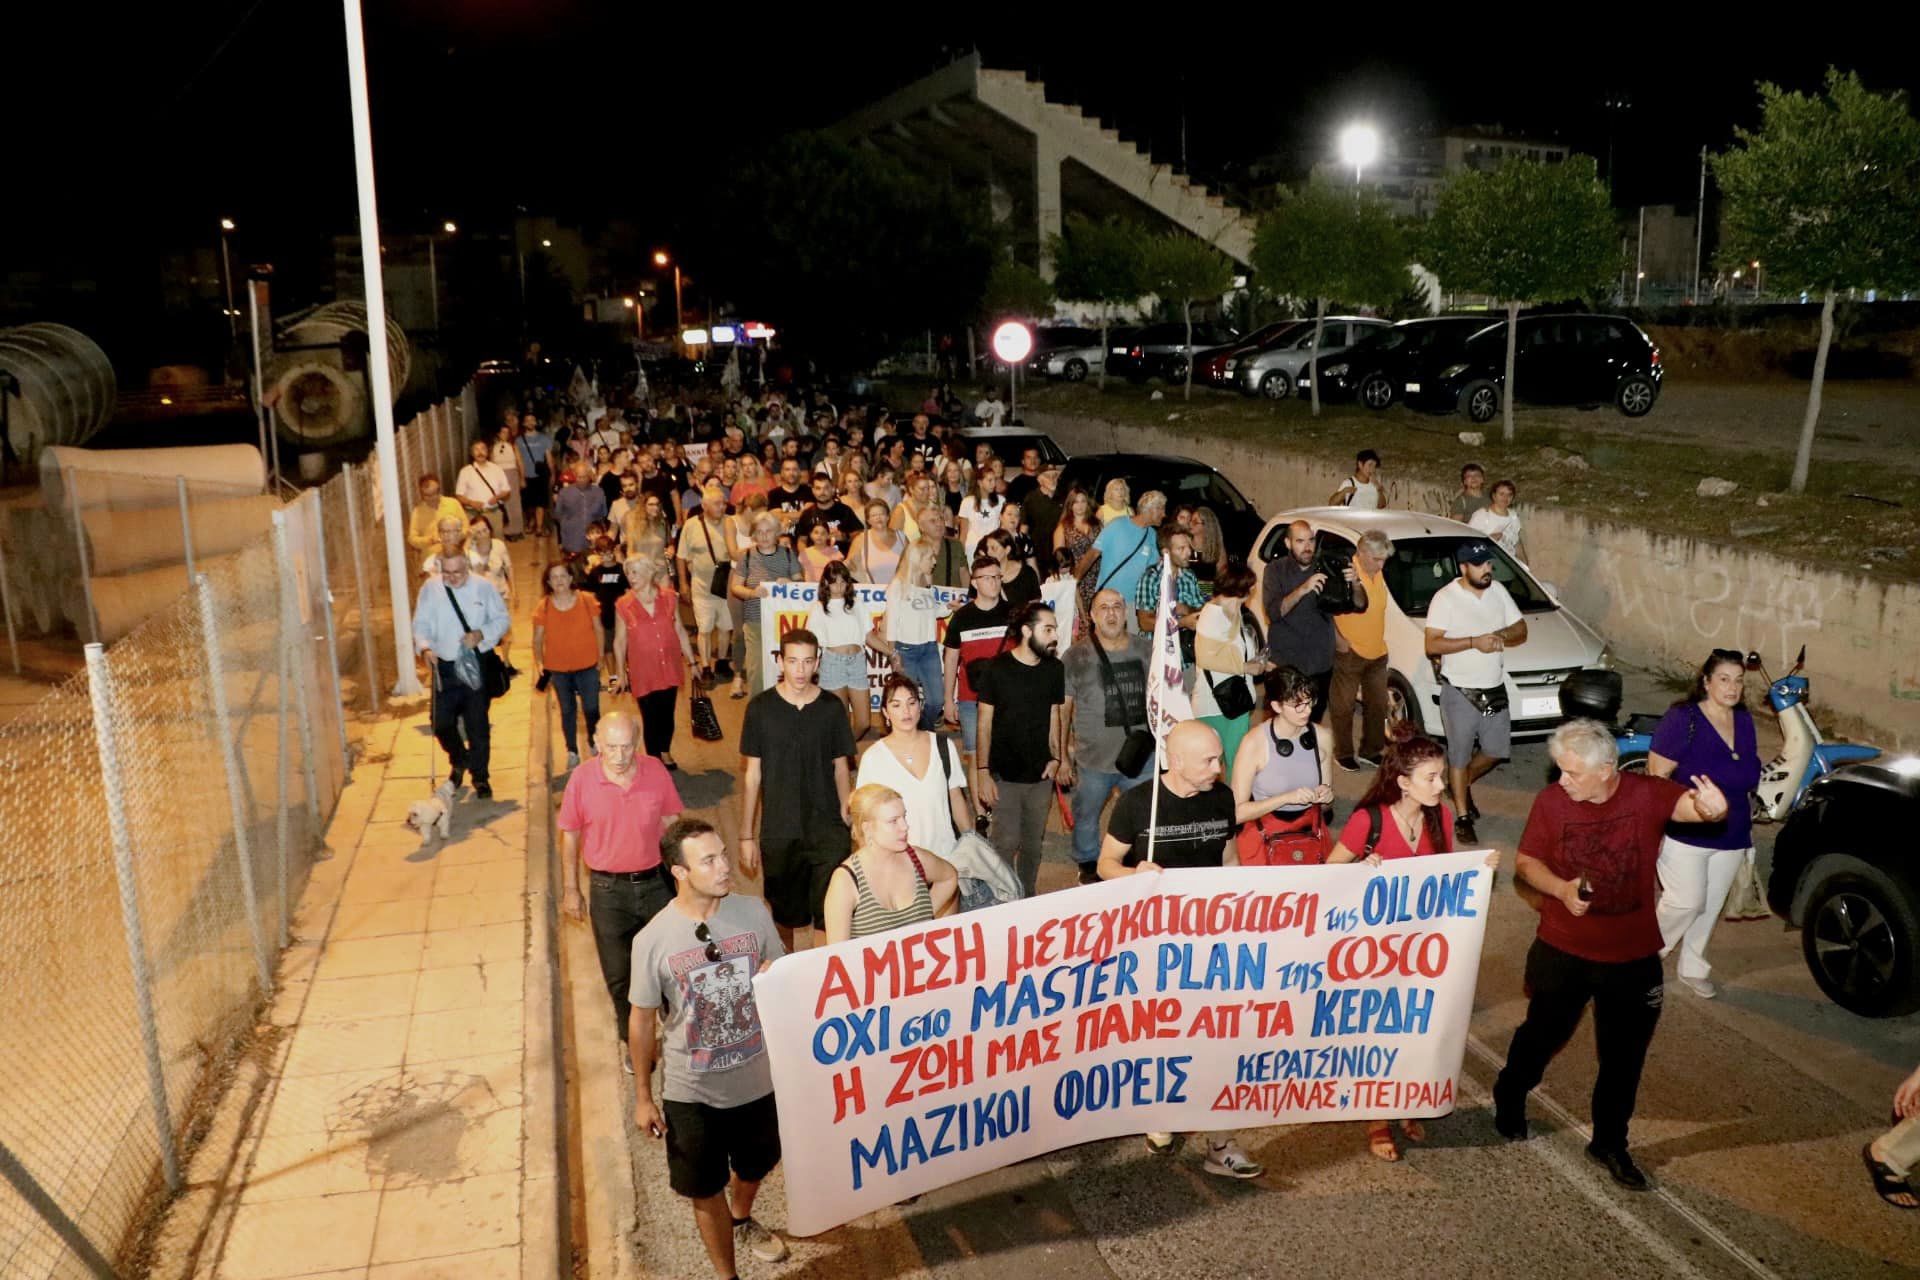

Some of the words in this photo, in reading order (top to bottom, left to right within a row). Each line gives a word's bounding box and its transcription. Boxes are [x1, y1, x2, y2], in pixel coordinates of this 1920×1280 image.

[772, 584, 819, 602] Μέσ
[1362, 874, 1413, 927] OIL
[1416, 869, 1480, 921] ONE
[812, 1005, 891, 1065] ΟΧΙ
[900, 1008, 952, 1048] στο
[970, 950, 1139, 1033] MASTER
[1156, 942, 1268, 993] PLAN
[1276, 960, 1326, 994] της
[1327, 932, 1449, 983] COSCO
[814, 922, 986, 1019] ΑΜΕΣΗ
[1324, 906, 1360, 933] της
[833, 1066, 866, 1125] Η
[885, 1034, 974, 1108] ΖΩΗ
[986, 1020, 1062, 1078] ΜΑΣ
[1075, 998, 1183, 1054] ΠΑΝΩ
[1310, 986, 1435, 1038] ΚΕΡΔΗ
[1210, 1077, 1339, 1118] ΔΡΑΠ/ΝΑΣ
[1353, 1076, 1453, 1110] ΠΕΙΡΑΙΑ
[1235, 1045, 1399, 1084] ΚΕΡΑΤΣΙΝΙΟΥ
[850, 1085, 1031, 1191] ΜΑΖΙΚΟΙ
[1054, 1055, 1193, 1120] ΦΟΡΕΙΣ
